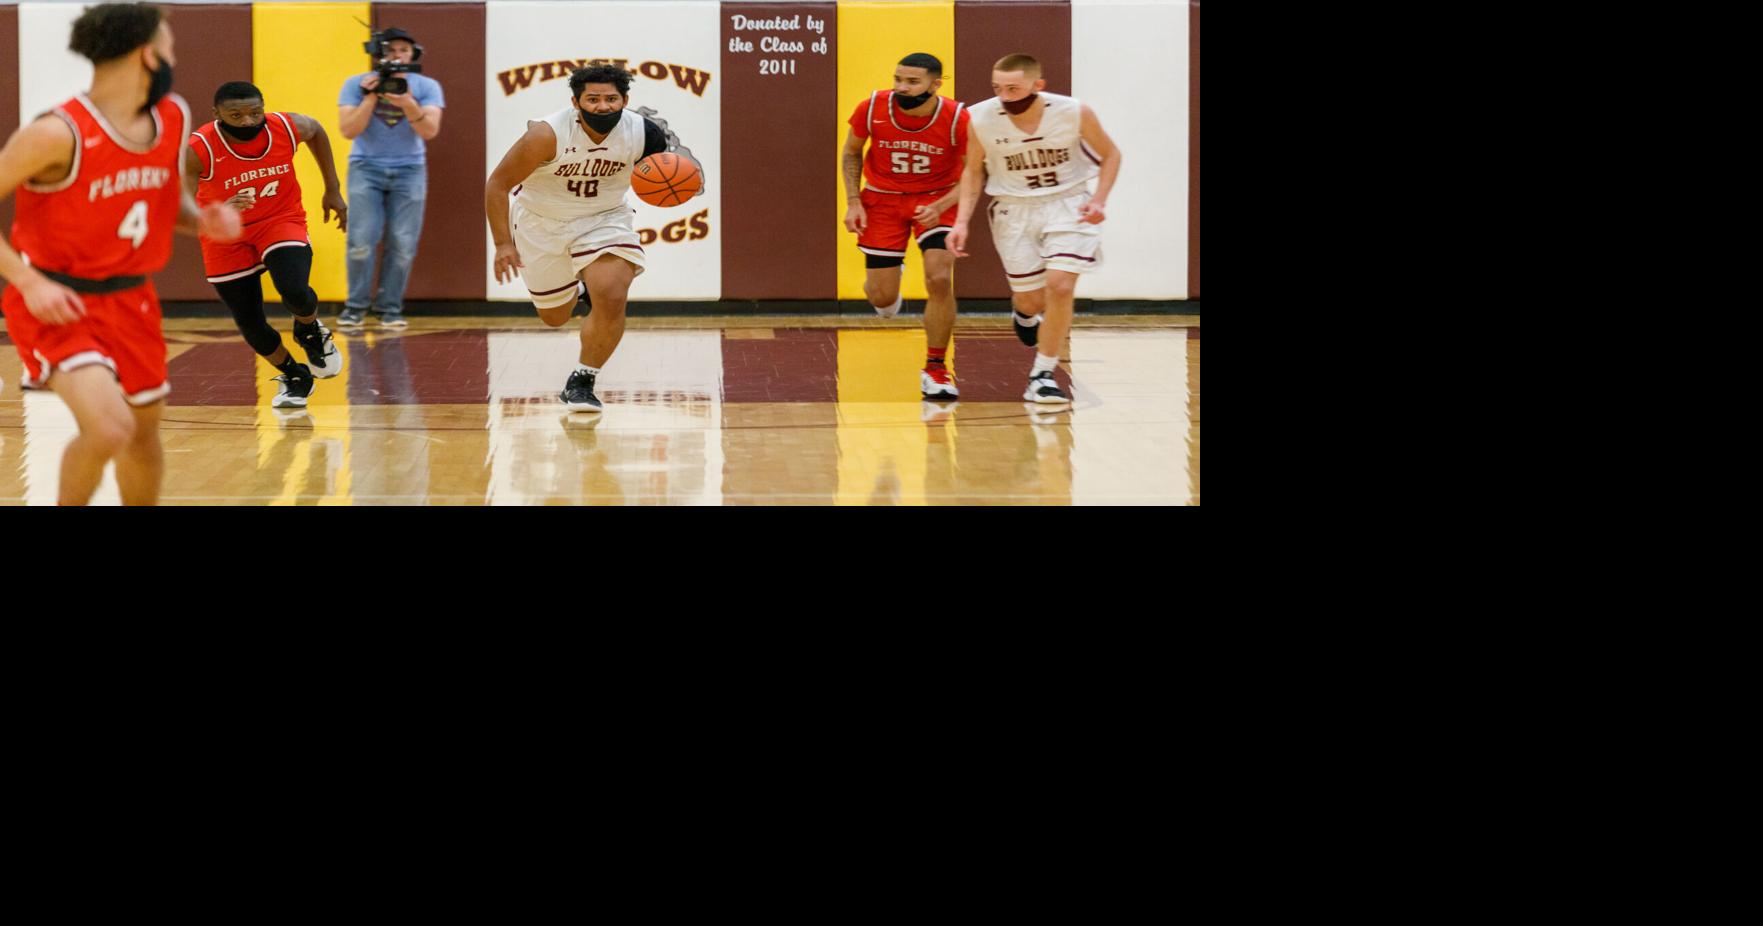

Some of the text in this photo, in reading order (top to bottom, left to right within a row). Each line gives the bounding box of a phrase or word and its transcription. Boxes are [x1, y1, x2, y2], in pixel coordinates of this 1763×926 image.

[730, 14, 825, 34] Donated by
[728, 36, 828, 54] the Class of
[759, 59, 796, 75] 2011
[878, 140, 945, 155] FLORENCE
[890, 151, 931, 174] 52
[1003, 147, 1069, 171] BULLDOGS
[224, 163, 290, 190] FLORENCE
[1023, 171, 1060, 190] 33
[566, 179, 600, 198] 40
[117, 198, 149, 251] 4
